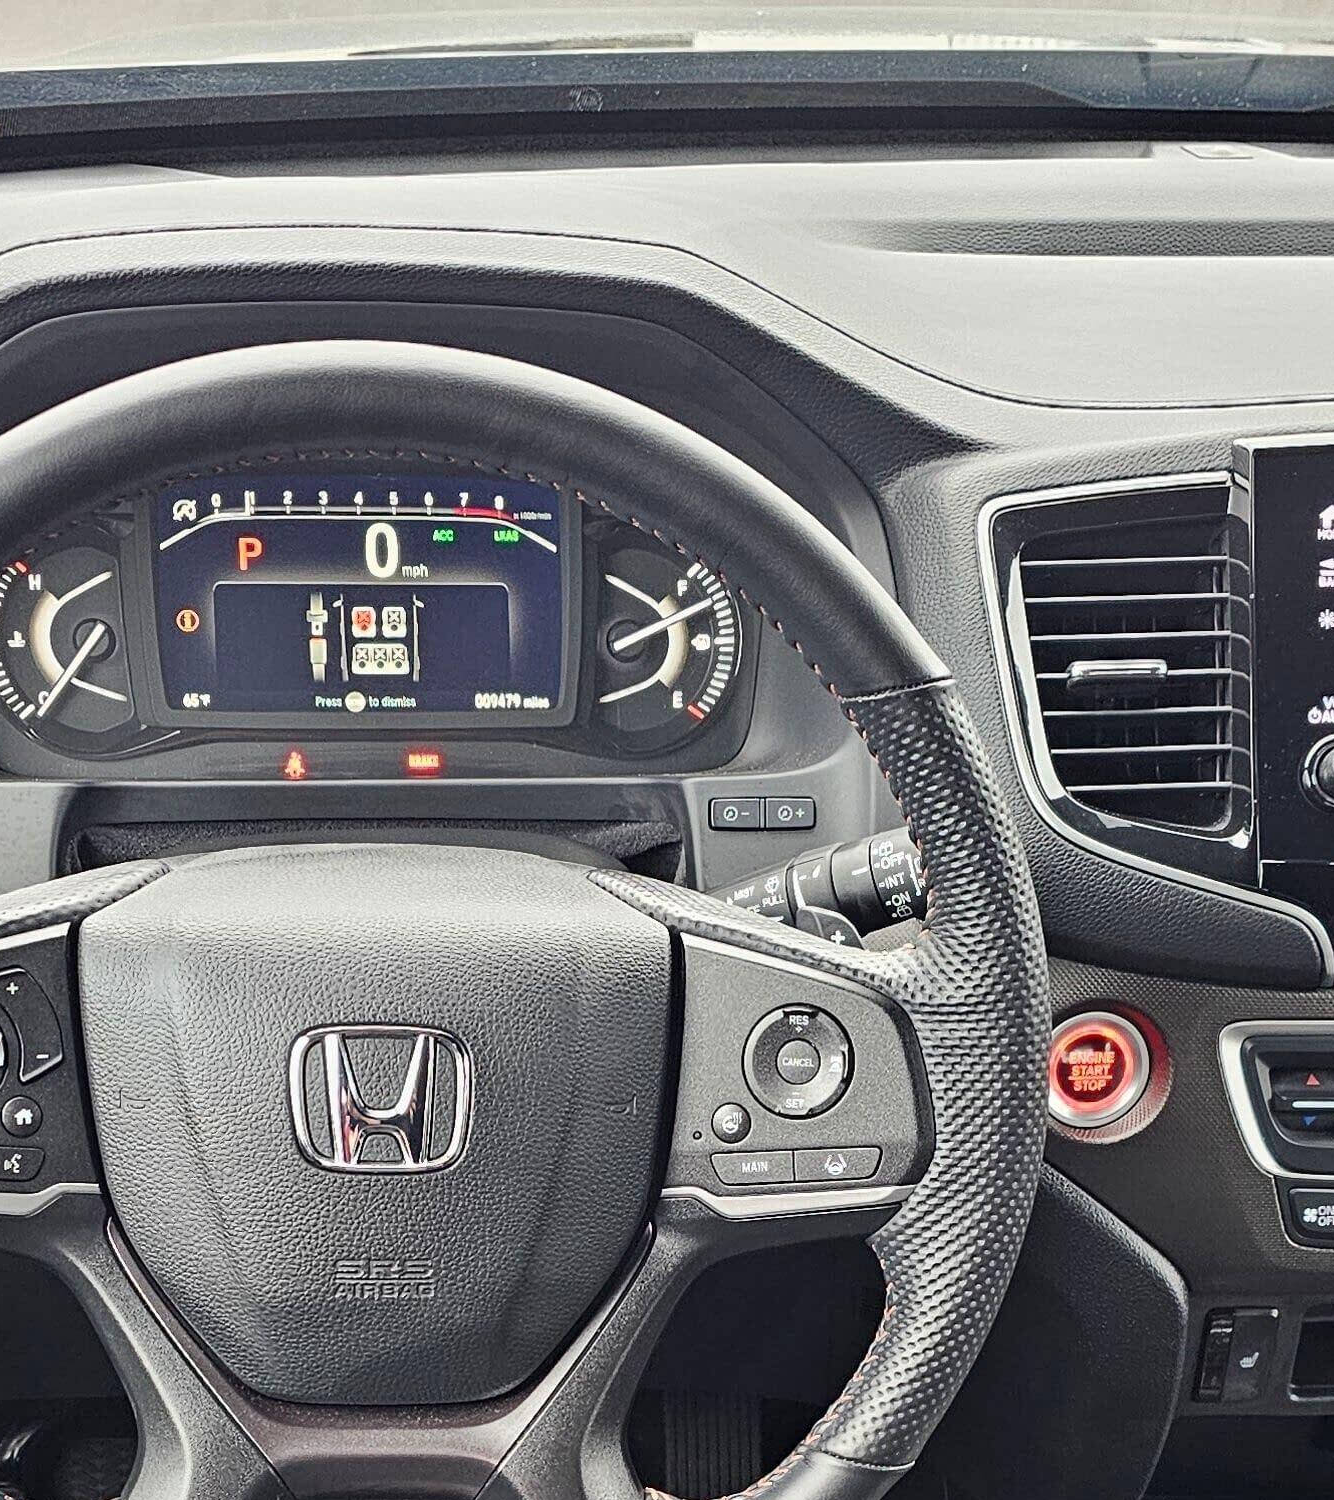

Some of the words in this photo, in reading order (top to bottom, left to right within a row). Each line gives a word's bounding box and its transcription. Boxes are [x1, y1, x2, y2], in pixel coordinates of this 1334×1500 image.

[238, 536, 264, 572] P
[365, 522, 400, 579] 0
[401, 563, 429, 579] mph
[27, 573, 42, 591] H
[676, 579, 688, 597] F
[314, 695, 343, 708] Press
[368, 695, 380, 708] to
[380, 695, 417, 708] dismiss
[522, 697, 550, 709] miles
[672, 690, 684, 709] E
[880, 850, 905, 871] OFF
[884, 871, 905, 890] INT
[891, 891, 912, 907] ON
[789, 1015, 809, 1027] RES
[782, 1056, 815, 1068] CANCEL
[1067, 1051, 1116, 1065] ENGINE
[1071, 1065, 1110, 1077] START
[1073, 1079, 1107, 1091] STOP
[741, 1162, 769, 1174] MAIN
[333, 1258, 435, 1280] SRS
[333, 1281, 436, 1299] AIRBAG
